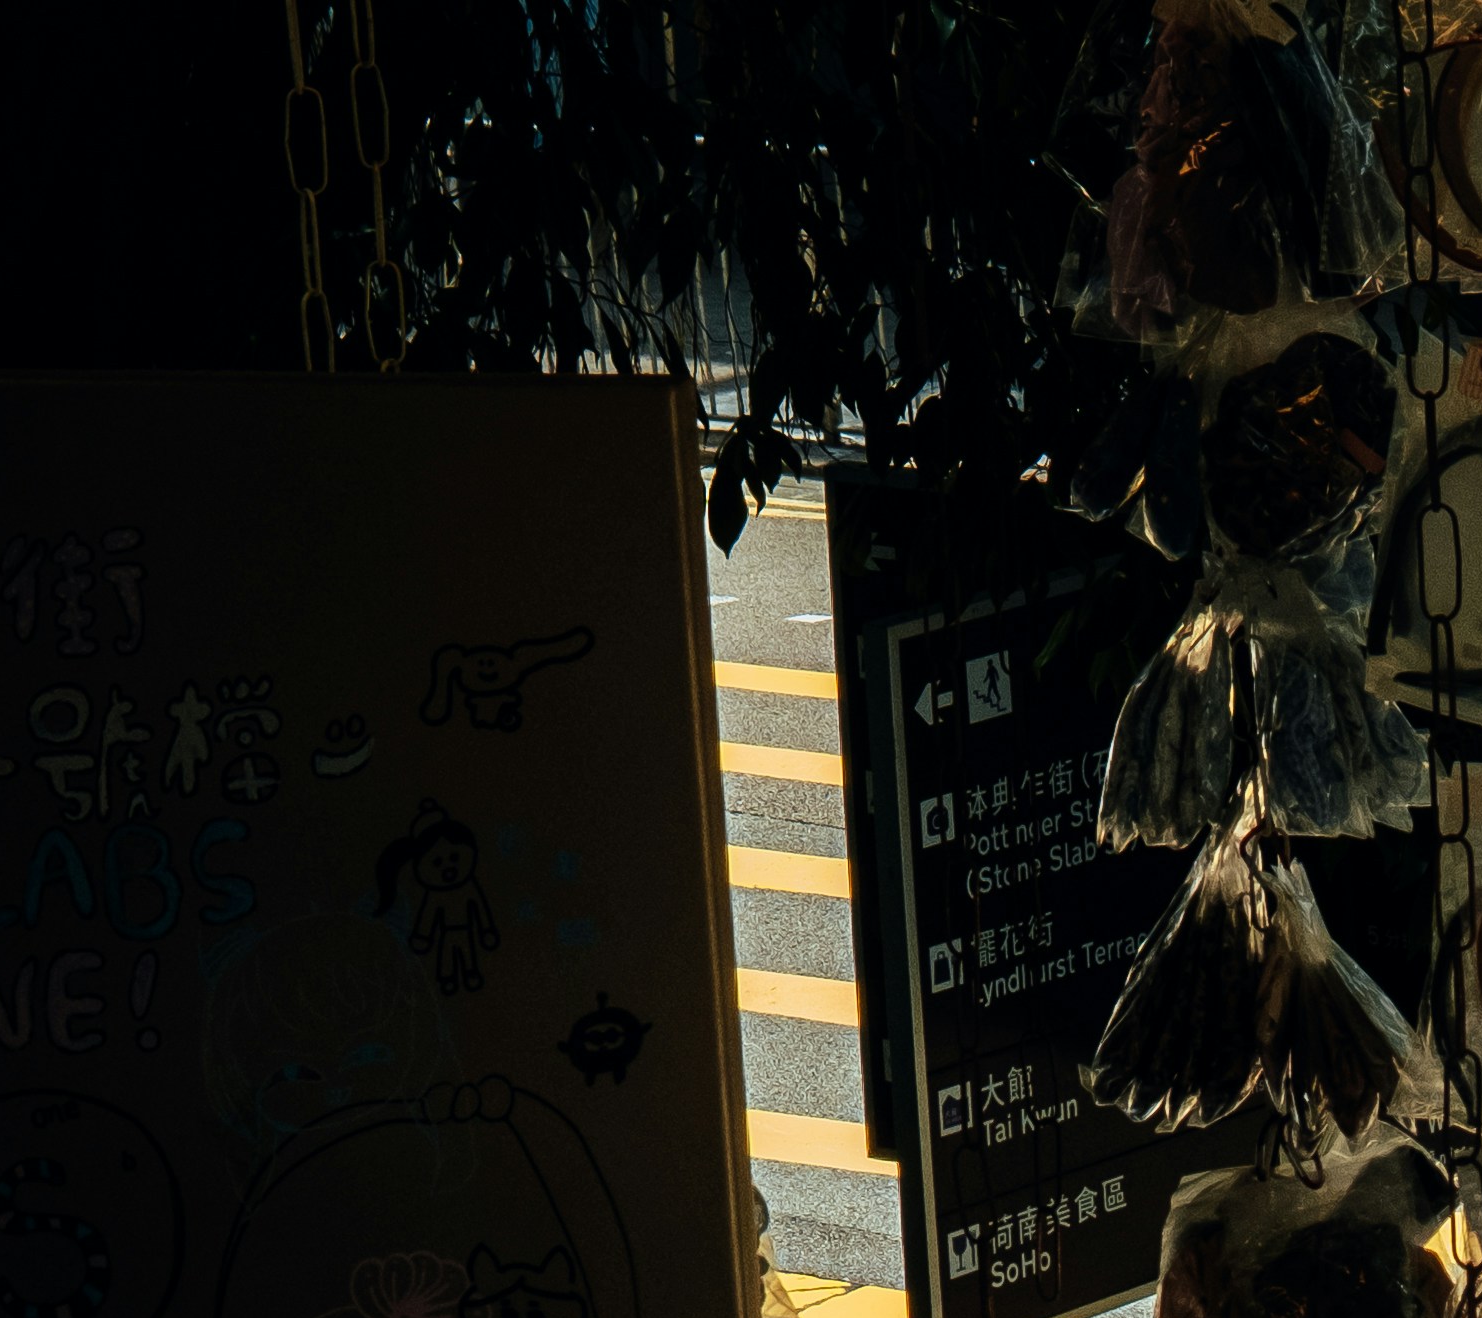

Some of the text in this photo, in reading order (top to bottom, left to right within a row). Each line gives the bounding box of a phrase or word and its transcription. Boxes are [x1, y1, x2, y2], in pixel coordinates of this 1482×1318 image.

[1048, 836, 1097, 873] Slab
[982, 1112, 1013, 1147] Tai
[990, 1249, 1052, 1289] SoHo
